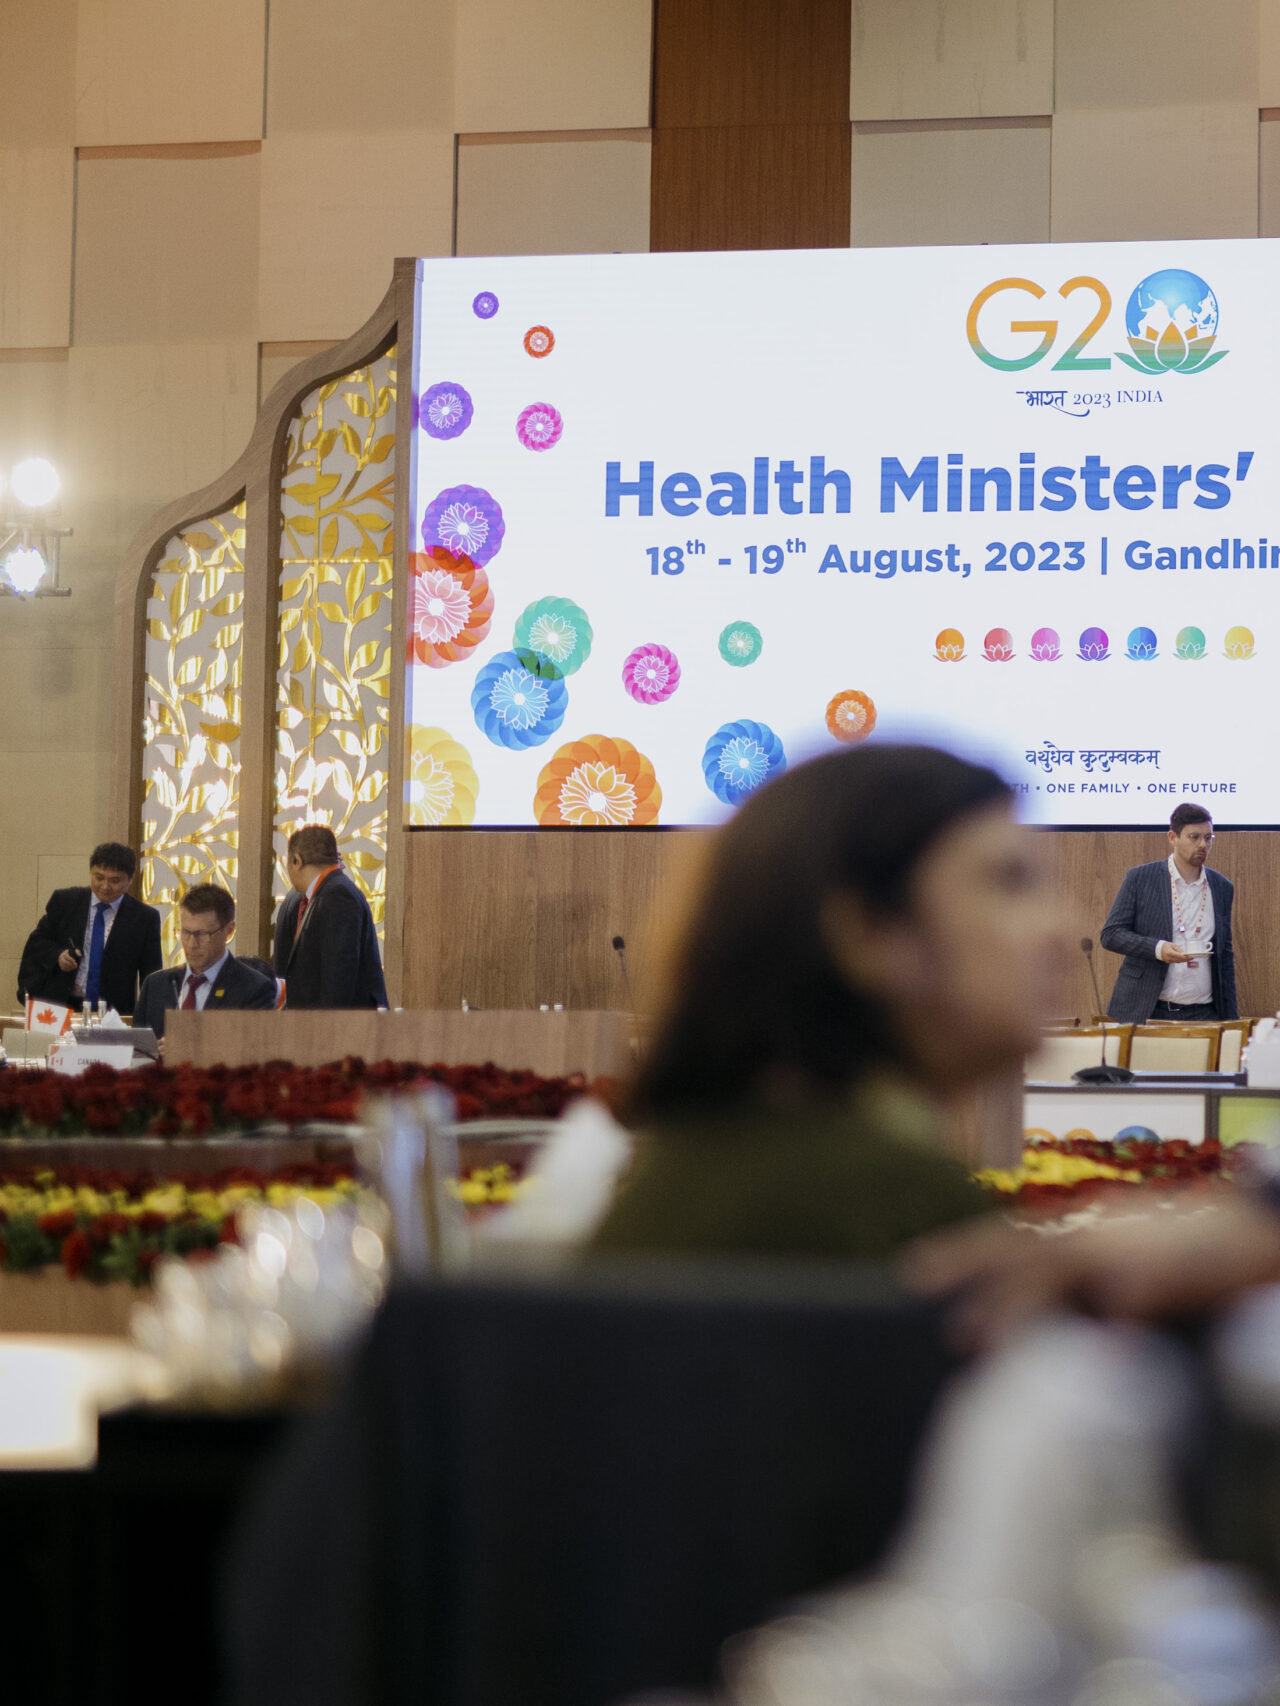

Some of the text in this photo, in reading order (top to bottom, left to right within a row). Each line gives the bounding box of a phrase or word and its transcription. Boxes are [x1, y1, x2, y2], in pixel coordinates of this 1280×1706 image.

[1073, 393, 1111, 408] 2023
[1117, 390, 1163, 404] INDIA
[605, 456, 852, 517] Health
[880, 451, 1255, 513] Ministers'
[646, 539, 706, 576] 18th
[744, 538, 807, 575] 19th
[818, 543, 972, 580] August,
[984, 541, 1086, 572] 2023
[1046, 782, 1237, 794] ONE FAMILY ONE FUTURE
